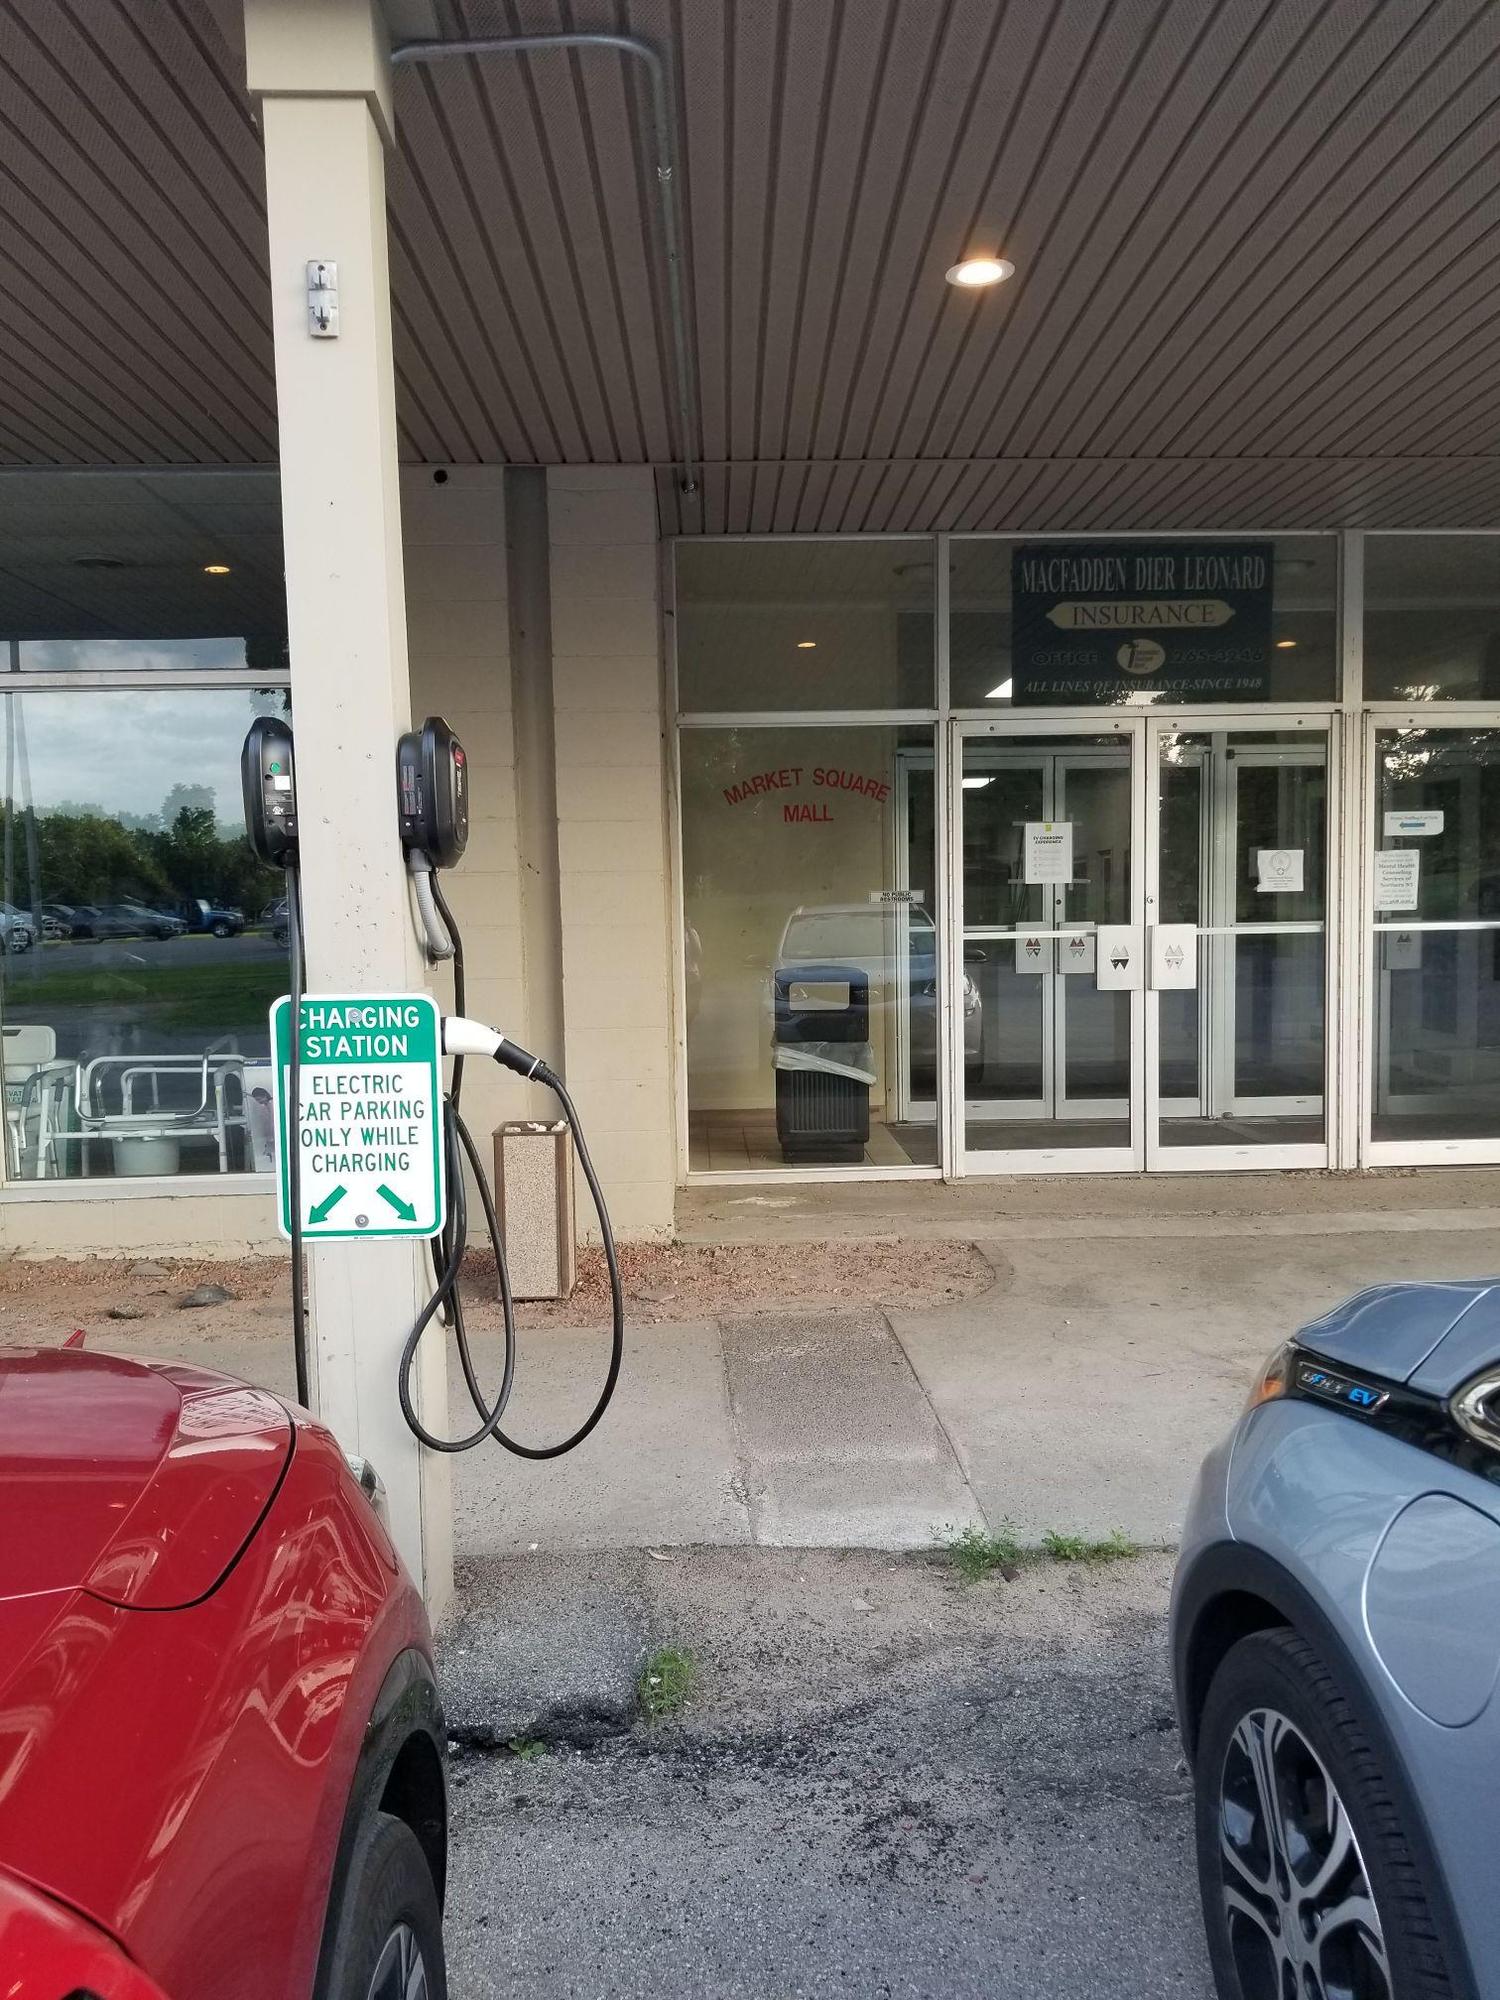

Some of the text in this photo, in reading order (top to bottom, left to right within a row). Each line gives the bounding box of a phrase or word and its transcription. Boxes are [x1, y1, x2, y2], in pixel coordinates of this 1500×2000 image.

[1021, 556, 1265, 593] MACFADDEN DIER LEONARD
[1072, 604, 1216, 625] INSURANCE
[1024, 680, 1049, 693] ALL
[1051, 680, 1092, 693] LINES
[722, 767, 891, 806] MARKET SQUARE
[783, 804, 834, 822] MALL
[306, 1035, 408, 1057] STATION
[313, 1074, 403, 1095] ELECTRIC
[341, 1100, 425, 1121] PARKING
[301, 1126, 419, 1148] ONLY WHILE
[312, 1152, 410, 1173] CHARGING
[1348, 1387, 1378, 1406] EV
